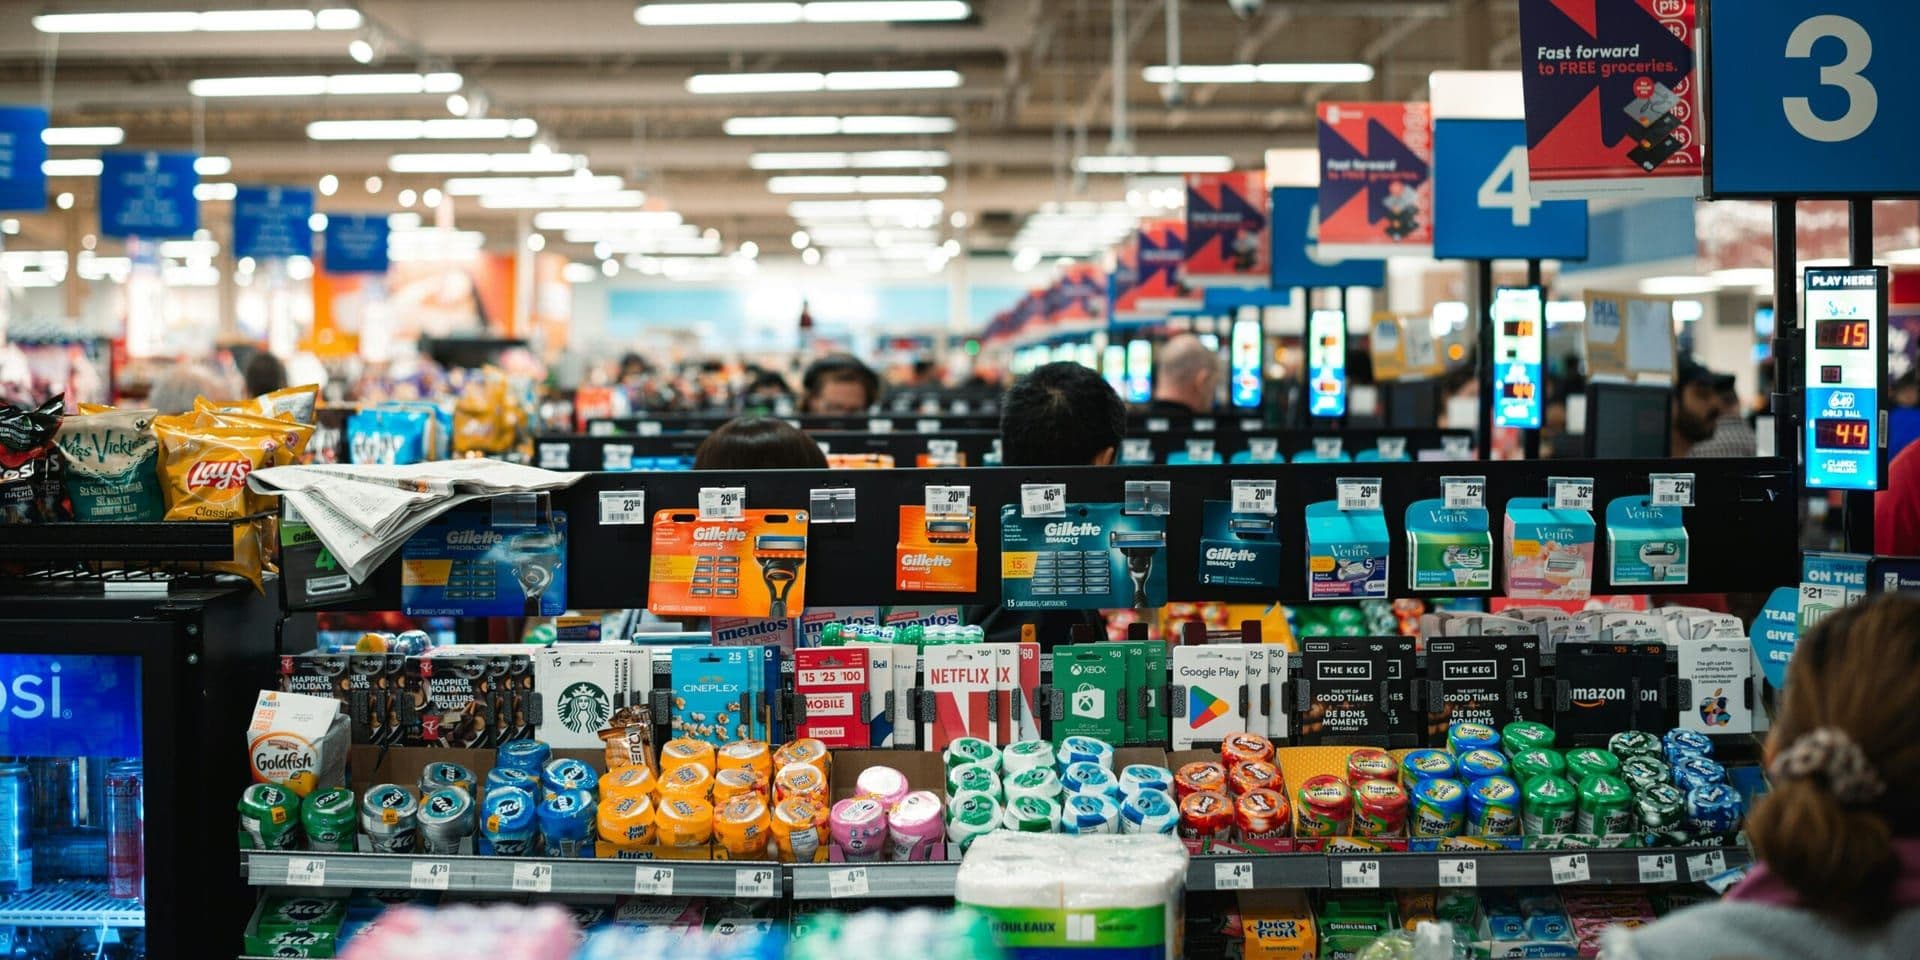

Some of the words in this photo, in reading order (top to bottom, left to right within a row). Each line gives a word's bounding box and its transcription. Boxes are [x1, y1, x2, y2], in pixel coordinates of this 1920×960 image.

[1538, 45, 1572, 60] Fast
[1576, 44, 1640, 60] forward
[1538, 62, 1554, 76] to
[1560, 62, 1596, 74] FREE
[1600, 60, 1678, 78] groceries.
[1782, 14, 1878, 142] 3
[1478, 146, 1541, 226] 4
[1812, 276, 1841, 286] PLAY
[1843, 276, 1874, 286] HERE
[1842, 322, 1868, 346] 15
[1836, 424, 1868, 444] 44
[190, 461, 249, 489] Lay's
[195, 506, 234, 518] Classic
[1430, 510, 1468, 523] Venus
[1626, 506, 1664, 519] Venus
[694, 526, 746, 542] Gillette
[1044, 522, 1101, 536] Gillette
[1536, 528, 1574, 540] Venus
[446, 530, 503, 545] Gillette
[1331, 545, 1370, 557] Venus
[1470, 548, 1478, 559] 5
[1667, 543, 1674, 554] 5
[902, 554, 952, 566] Gillette
[1206, 548, 1256, 562] Gillette
[1366, 558, 1372, 568] 5
[1204, 574, 1210, 584] 5
[1808, 570, 1831, 582] ON
[1833, 572, 1864, 584] THE
[901, 580, 906, 590] 4
[1803, 588, 1822, 599] $21
[1764, 610, 1796, 622] TEAR
[718, 618, 788, 642] mentos
[1766, 630, 1794, 642] GIVE
[728, 652, 742, 660] 25
[1250, 651, 1264, 660] $25
[1270, 650, 1284, 658] $50
[872, 660, 888, 668] Bell
[1180, 666, 1216, 678] Google
[1219, 667, 1240, 679] Play
[1246, 666, 1260, 678] lay
[1324, 666, 1342, 674] THE
[1347, 666, 1365, 674] KEG
[1449, 666, 1469, 674] THE
[931, 668, 989, 684] NETFLIX
[290, 682, 332, 690] HOLIDAYS
[432, 678, 469, 686] HAPPIER
[683, 684, 738, 693] CINEPLEX
[430, 694, 474, 702] MEILLEURS
[1317, 694, 1344, 702] GOOD
[1347, 694, 1374, 702] TIMES
[1444, 694, 1470, 702] GOOD
[806, 700, 844, 708] MOBILE
[1326, 710, 1339, 718] DE
[1340, 710, 1365, 718] BONS
[1322, 718, 1368, 726] MOMENTS
[256, 752, 312, 771] Goldfish
[1254, 920, 1295, 931] Juicy
[1331, 923, 1377, 931] DOUBLEMINT
[1258, 929, 1296, 938] Fruit
